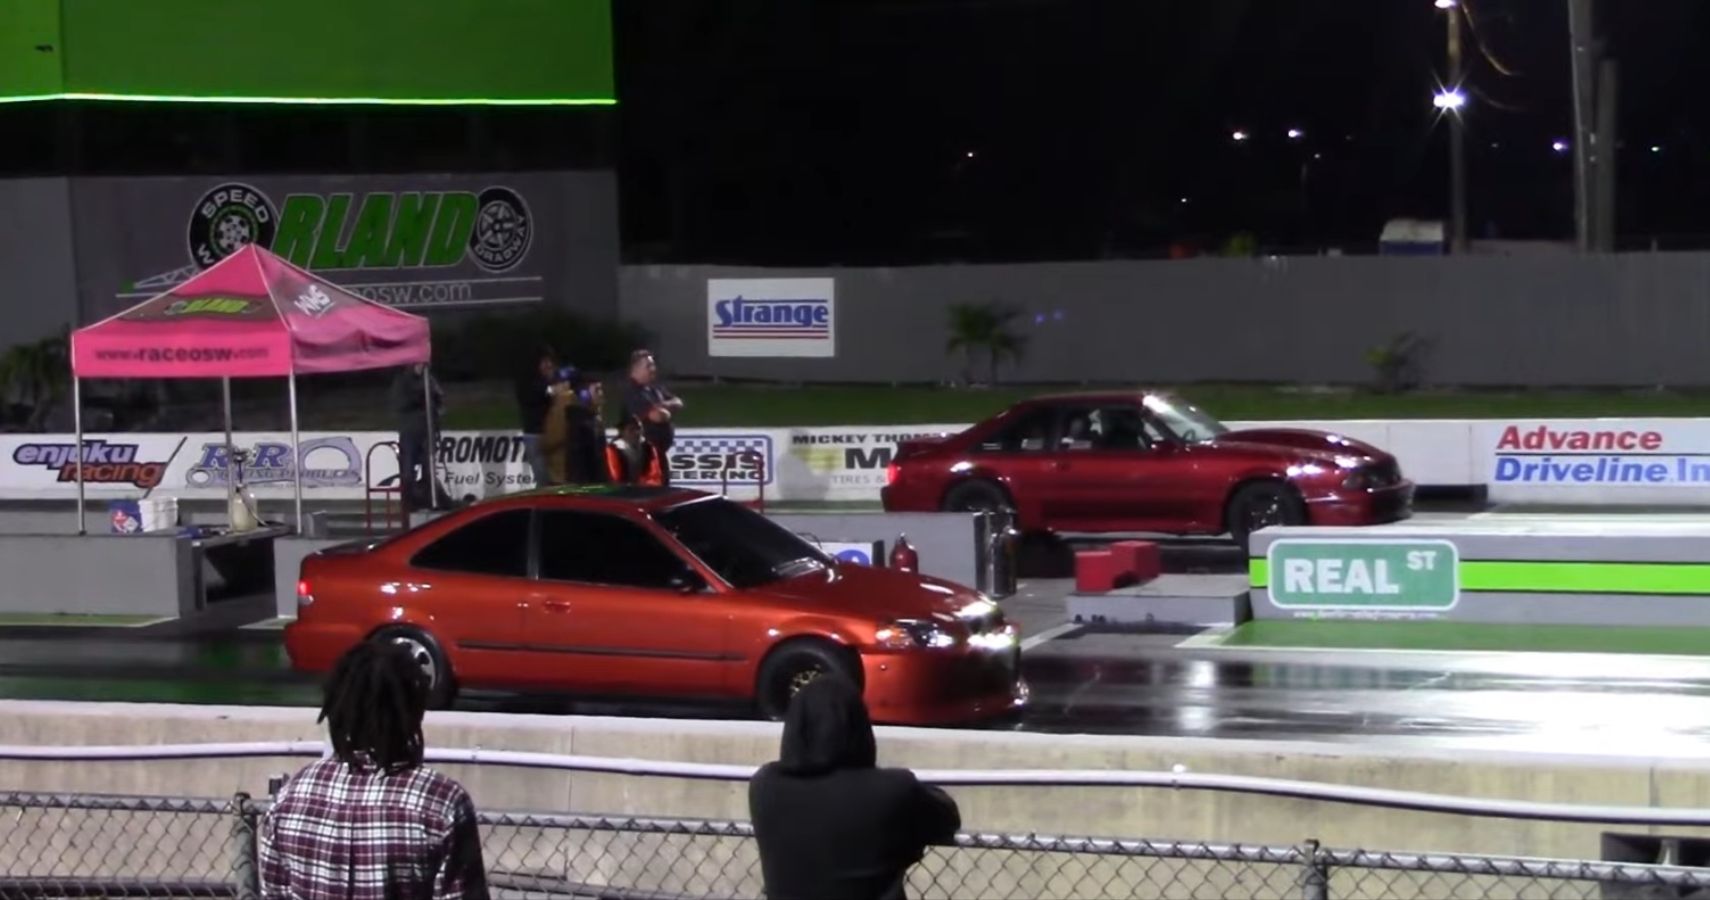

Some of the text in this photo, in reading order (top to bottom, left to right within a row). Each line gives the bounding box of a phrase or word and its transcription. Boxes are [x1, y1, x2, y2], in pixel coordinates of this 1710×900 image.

[201, 189, 269, 223] SPEED
[715, 295, 829, 328] Strange
[95, 346, 270, 362] www.raceosw.com
[436, 436, 529, 463] ROMOT
[792, 434, 867, 444] MICKEY
[1496, 425, 1663, 450] Advance
[14, 441, 138, 469] enjuku
[670, 454, 763, 470] SSIS
[60, 463, 165, 488] racing
[444, 472, 480, 485] Fuel
[485, 472, 536, 487] Syste
[670, 471, 763, 480] EERING
[1494, 457, 1668, 482] Driveline
[1284, 550, 1437, 595] REAL ST
